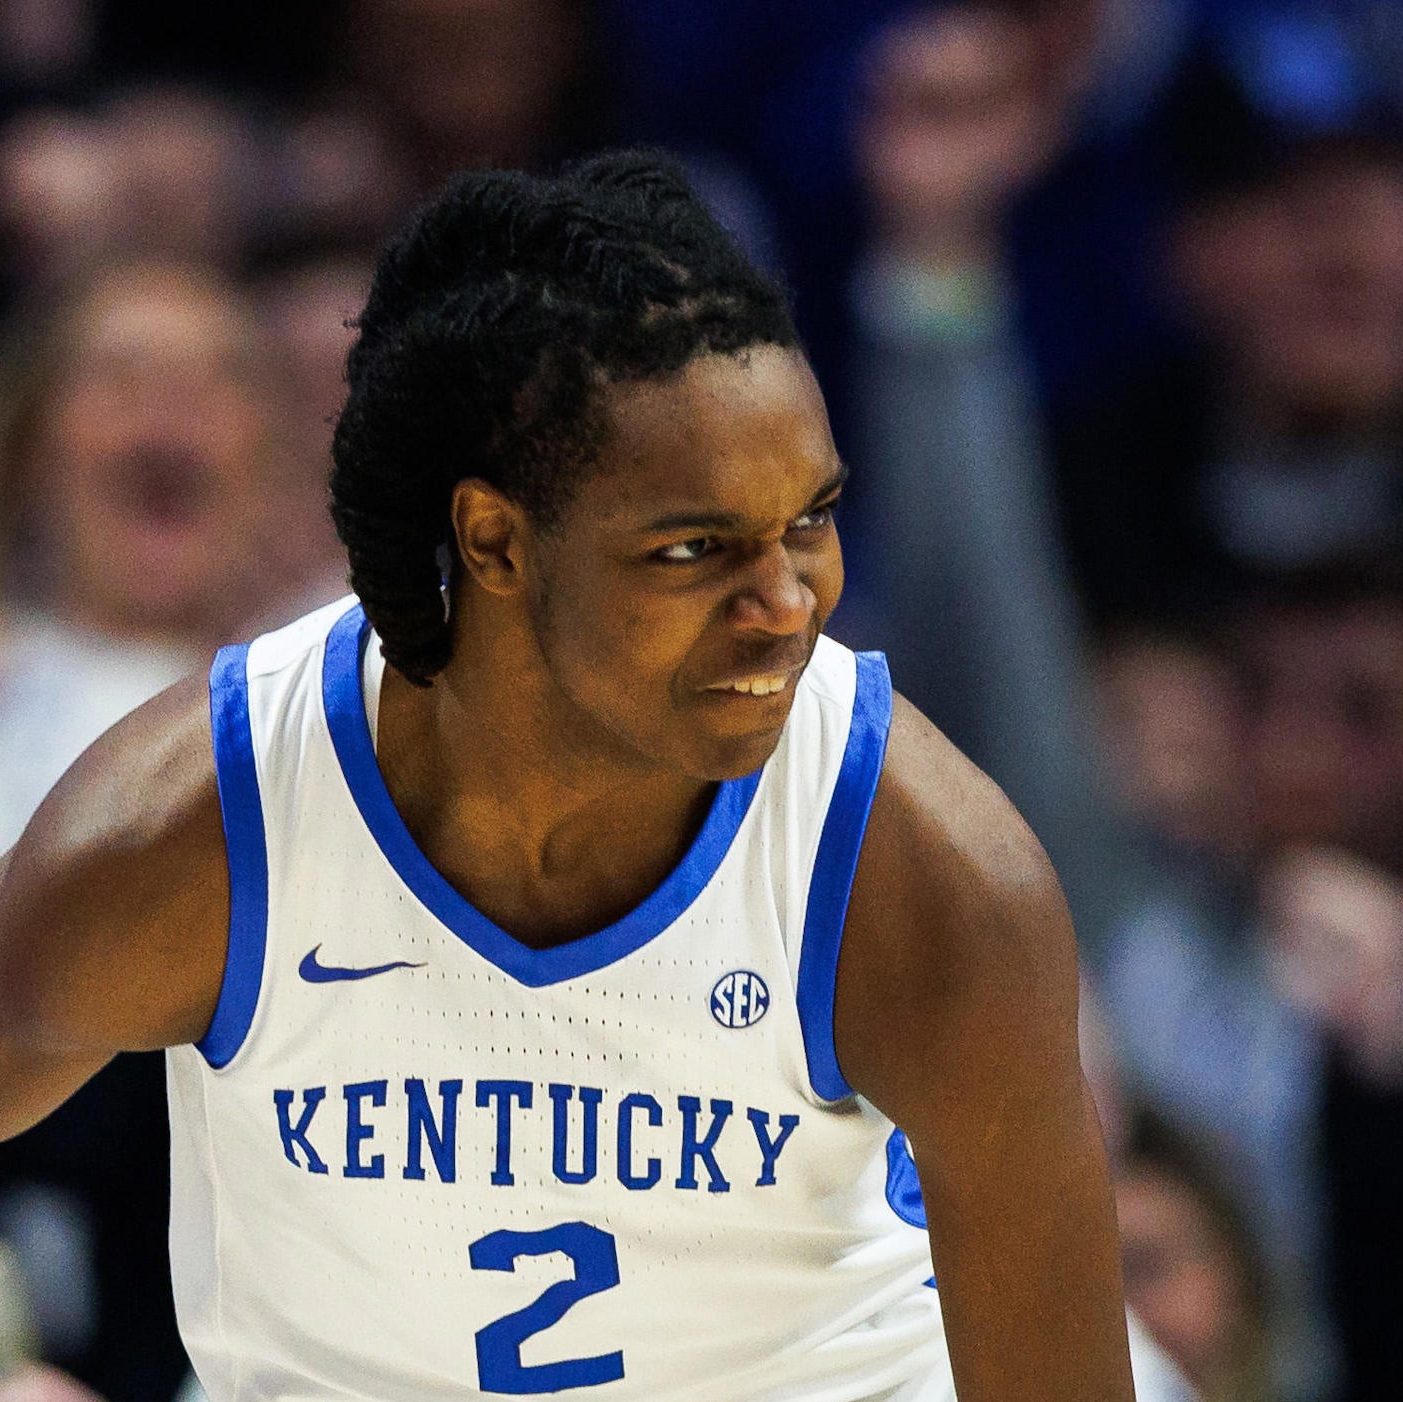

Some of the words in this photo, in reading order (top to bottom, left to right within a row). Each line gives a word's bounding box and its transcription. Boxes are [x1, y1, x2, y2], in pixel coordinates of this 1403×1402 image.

[713, 972, 767, 1027] SEC
[273, 1079, 799, 1192] KENTUCKY
[468, 1221, 625, 1396] 2
